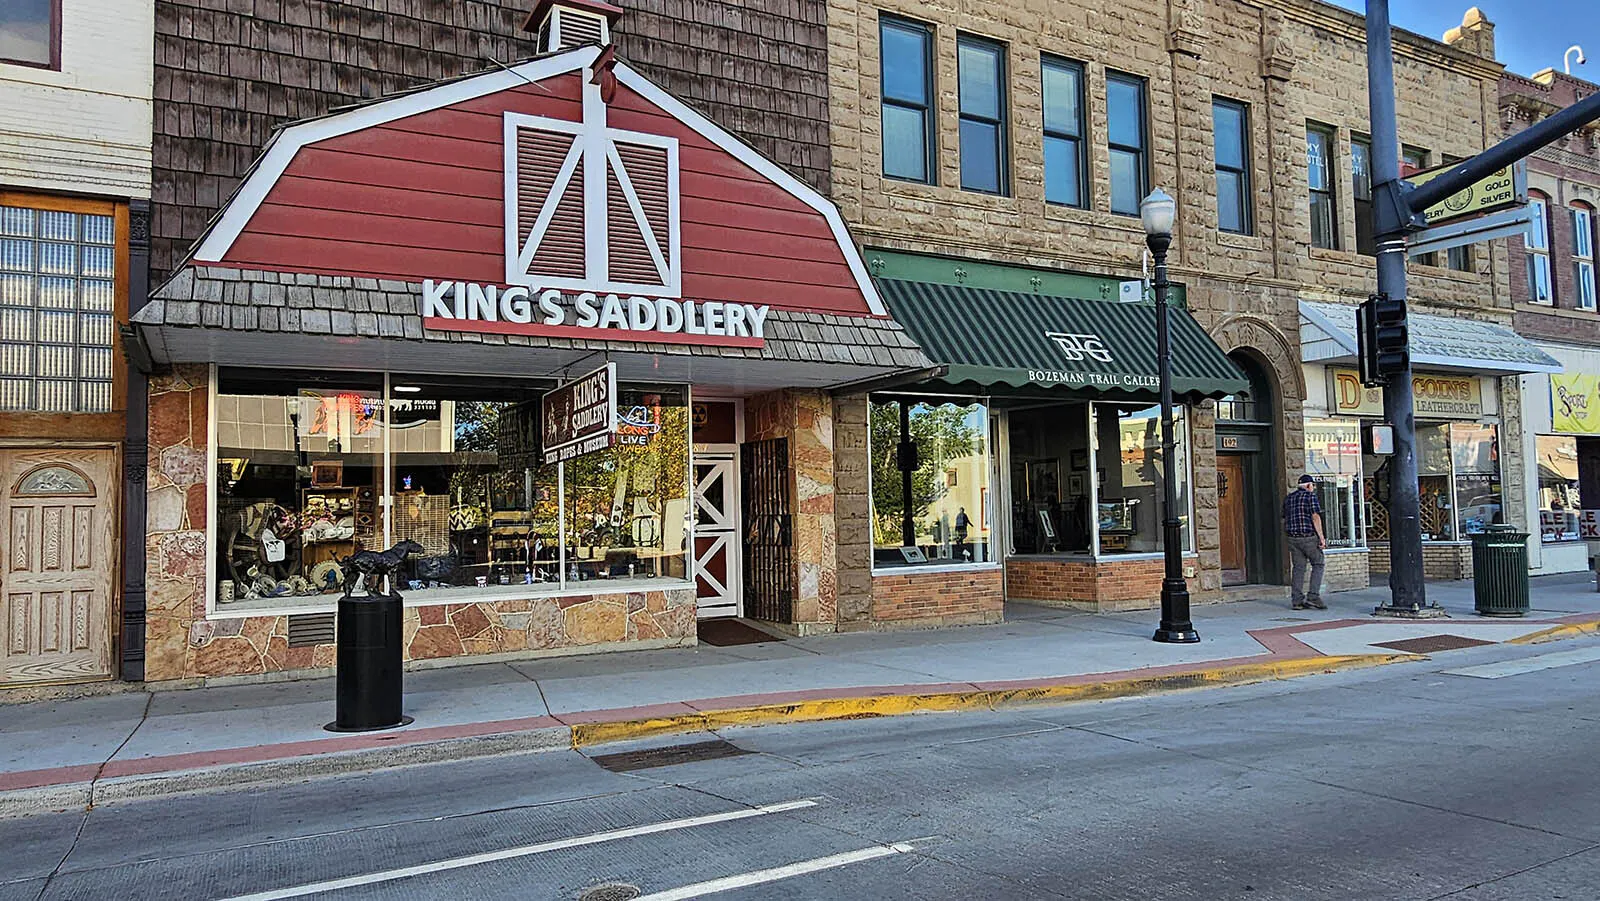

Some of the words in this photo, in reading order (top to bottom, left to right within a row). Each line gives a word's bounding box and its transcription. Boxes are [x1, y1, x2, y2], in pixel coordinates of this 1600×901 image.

[1485, 179, 1511, 192] GOLD
[1480, 191, 1512, 206] SILVER
[1425, 209, 1445, 220] ELRY
[422, 279, 565, 326] KING'S
[573, 292, 770, 338] SADDLERY
[1028, 370, 1085, 384] BOZEMAN
[1088, 373, 1120, 386] TRAIL
[1123, 375, 1161, 387] GALLER
[573, 371, 607, 411] KING'S
[1412, 377, 1472, 401] COINS
[1415, 400, 1481, 415] LEATHERCRAFT
[571, 401, 609, 438] SADDLERY
[616, 425, 649, 436] LONG
[583, 434, 609, 454] MUSEUM
[620, 435, 647, 445] LIVE
